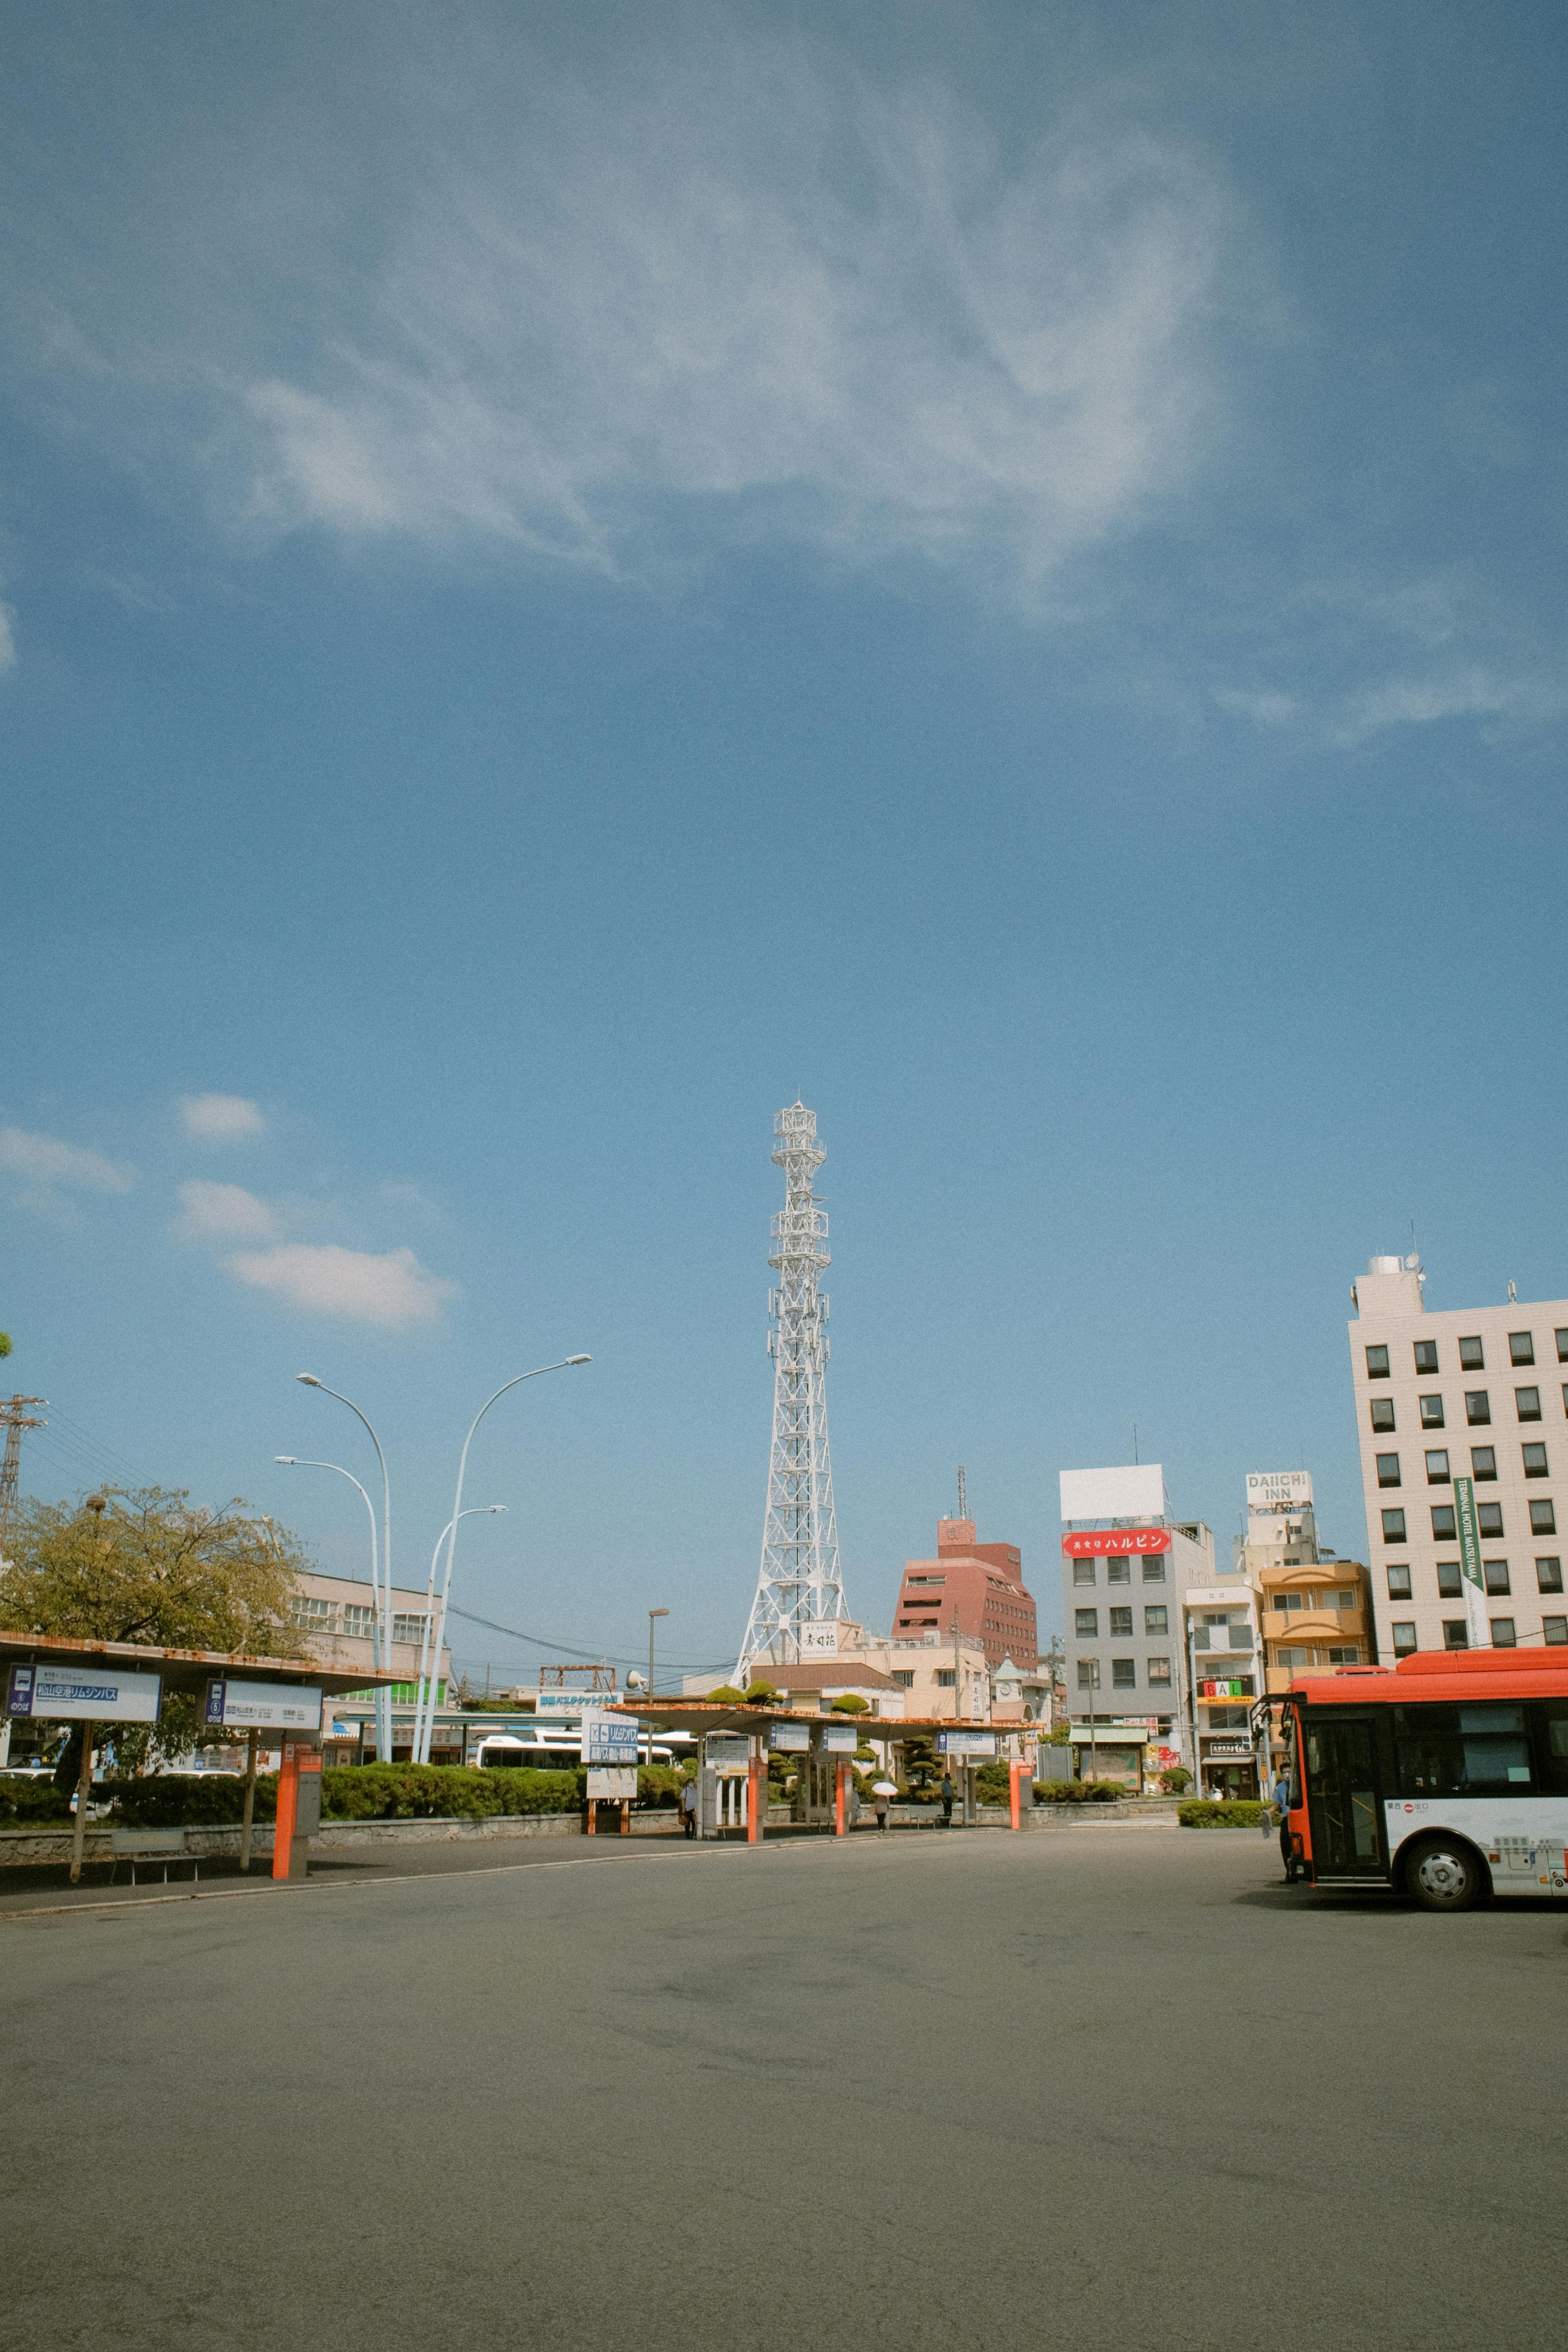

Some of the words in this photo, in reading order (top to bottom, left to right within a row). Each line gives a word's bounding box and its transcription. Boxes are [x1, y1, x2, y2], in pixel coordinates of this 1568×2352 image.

[1249, 1474, 1306, 1487] DAIICHI
[1266, 1488, 1291, 1499] INN
[1458, 1480, 1470, 1513] TERMINAL
[1462, 1513, 1472, 1536] HOTEL
[1465, 1536, 1477, 1579] MATSUYAMA
[38, 1684, 117, 1699] 松山空港リムジンバス
[1207, 1684, 1238, 1696] BAL
[11, 1702, 29, 1711] のりば
[611, 1727, 637, 1742] リムジンバス
